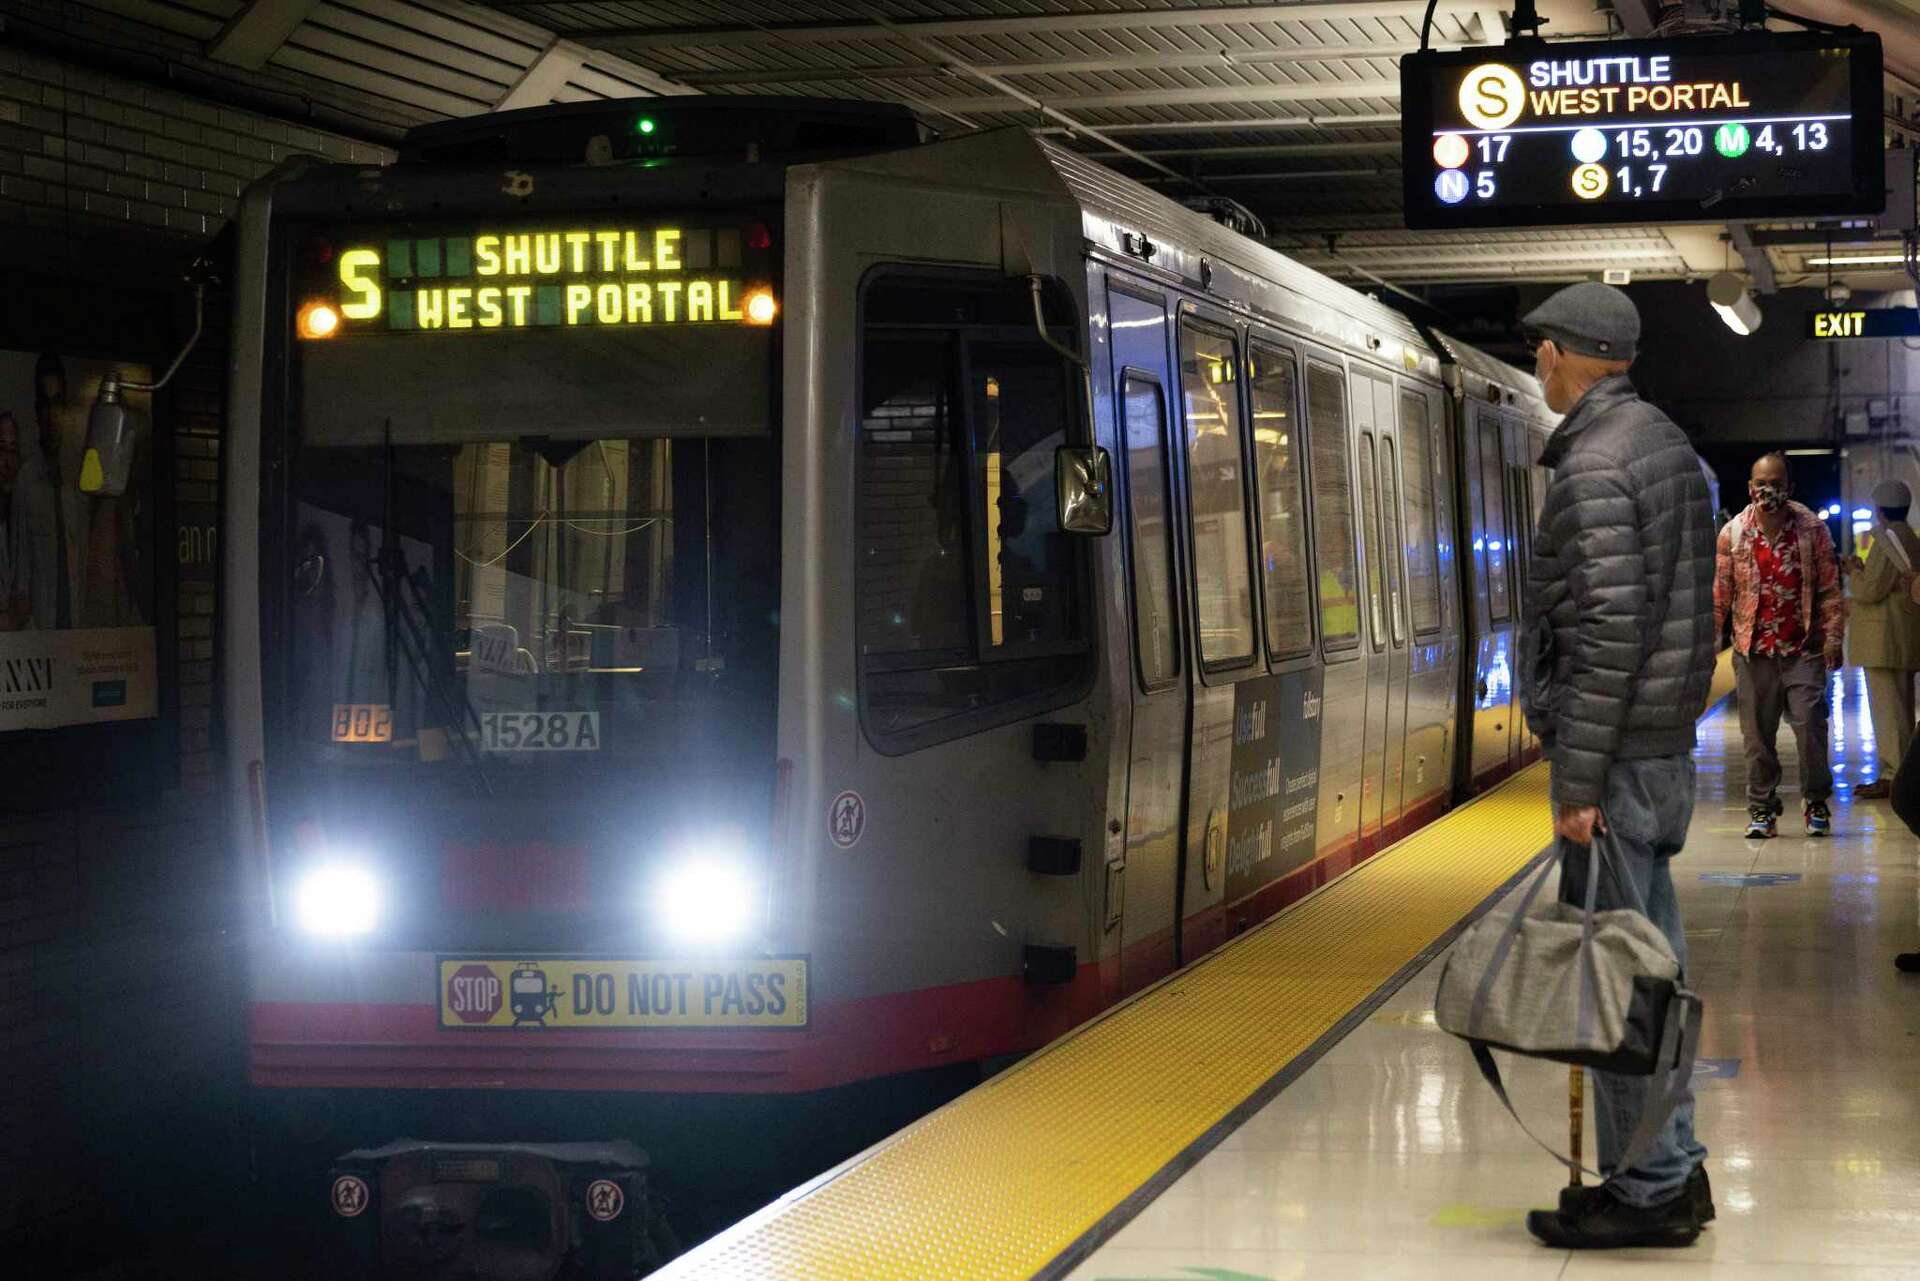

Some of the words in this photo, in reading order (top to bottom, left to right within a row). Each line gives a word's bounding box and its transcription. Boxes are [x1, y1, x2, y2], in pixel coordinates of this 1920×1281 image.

[1530, 56, 1671, 87] SHUTTLE
[1476, 76, 1509, 118] S
[1530, 87, 1620, 116] WEST
[1628, 82, 1750, 112] PORTAL
[1477, 135, 1511, 163] 17
[1718, 124, 1746, 152] M
[1441, 173, 1464, 201] N
[1476, 171, 1496, 198] 5
[1580, 168, 1601, 192] S
[475, 230, 682, 276] SHUTTLE
[339, 249, 382, 319] S
[416, 286, 531, 329] WEST
[566, 280, 744, 325] PORTAL
[1815, 311, 1866, 337] EXIT
[453, 976, 499, 1012] STOP
[573, 973, 615, 1016] DO
[628, 973, 691, 1016] NOT
[704, 973, 786, 1016] PASS
